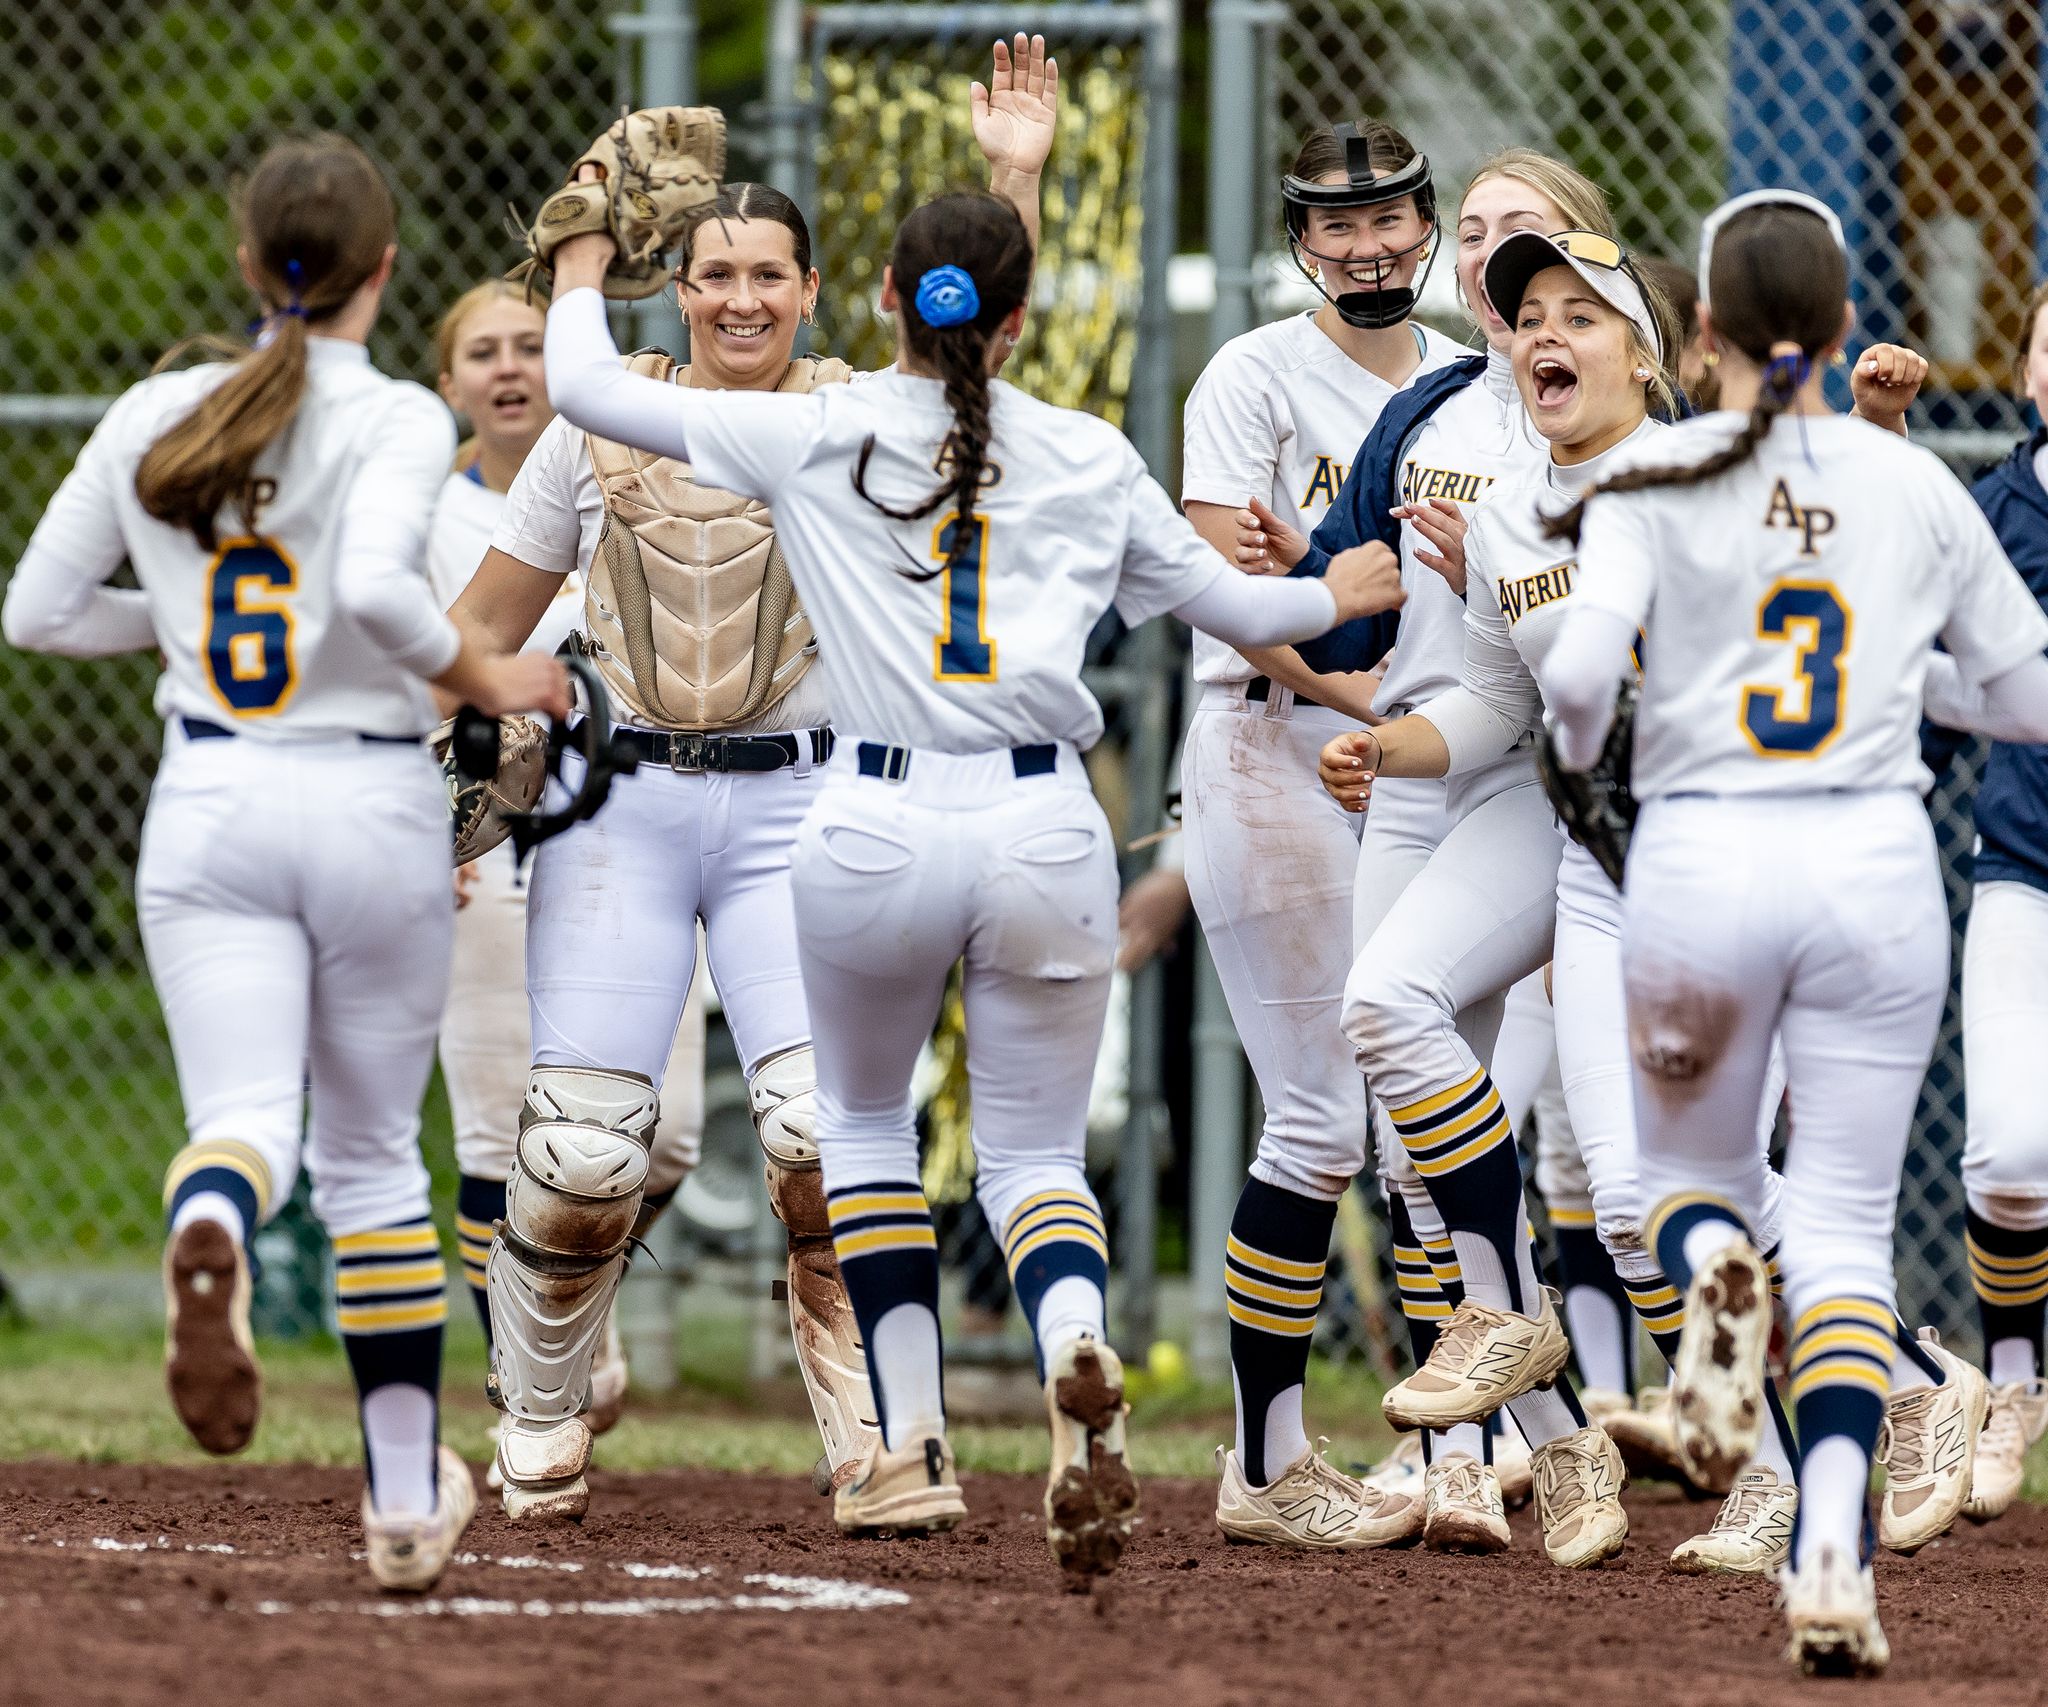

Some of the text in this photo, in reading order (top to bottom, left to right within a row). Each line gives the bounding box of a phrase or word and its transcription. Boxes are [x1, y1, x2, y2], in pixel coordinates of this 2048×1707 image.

[1403, 460, 1495, 503] AVERIL
[201, 534, 302, 719] 6
[930, 511, 998, 683] 1
[1738, 576, 1854, 760] 3
